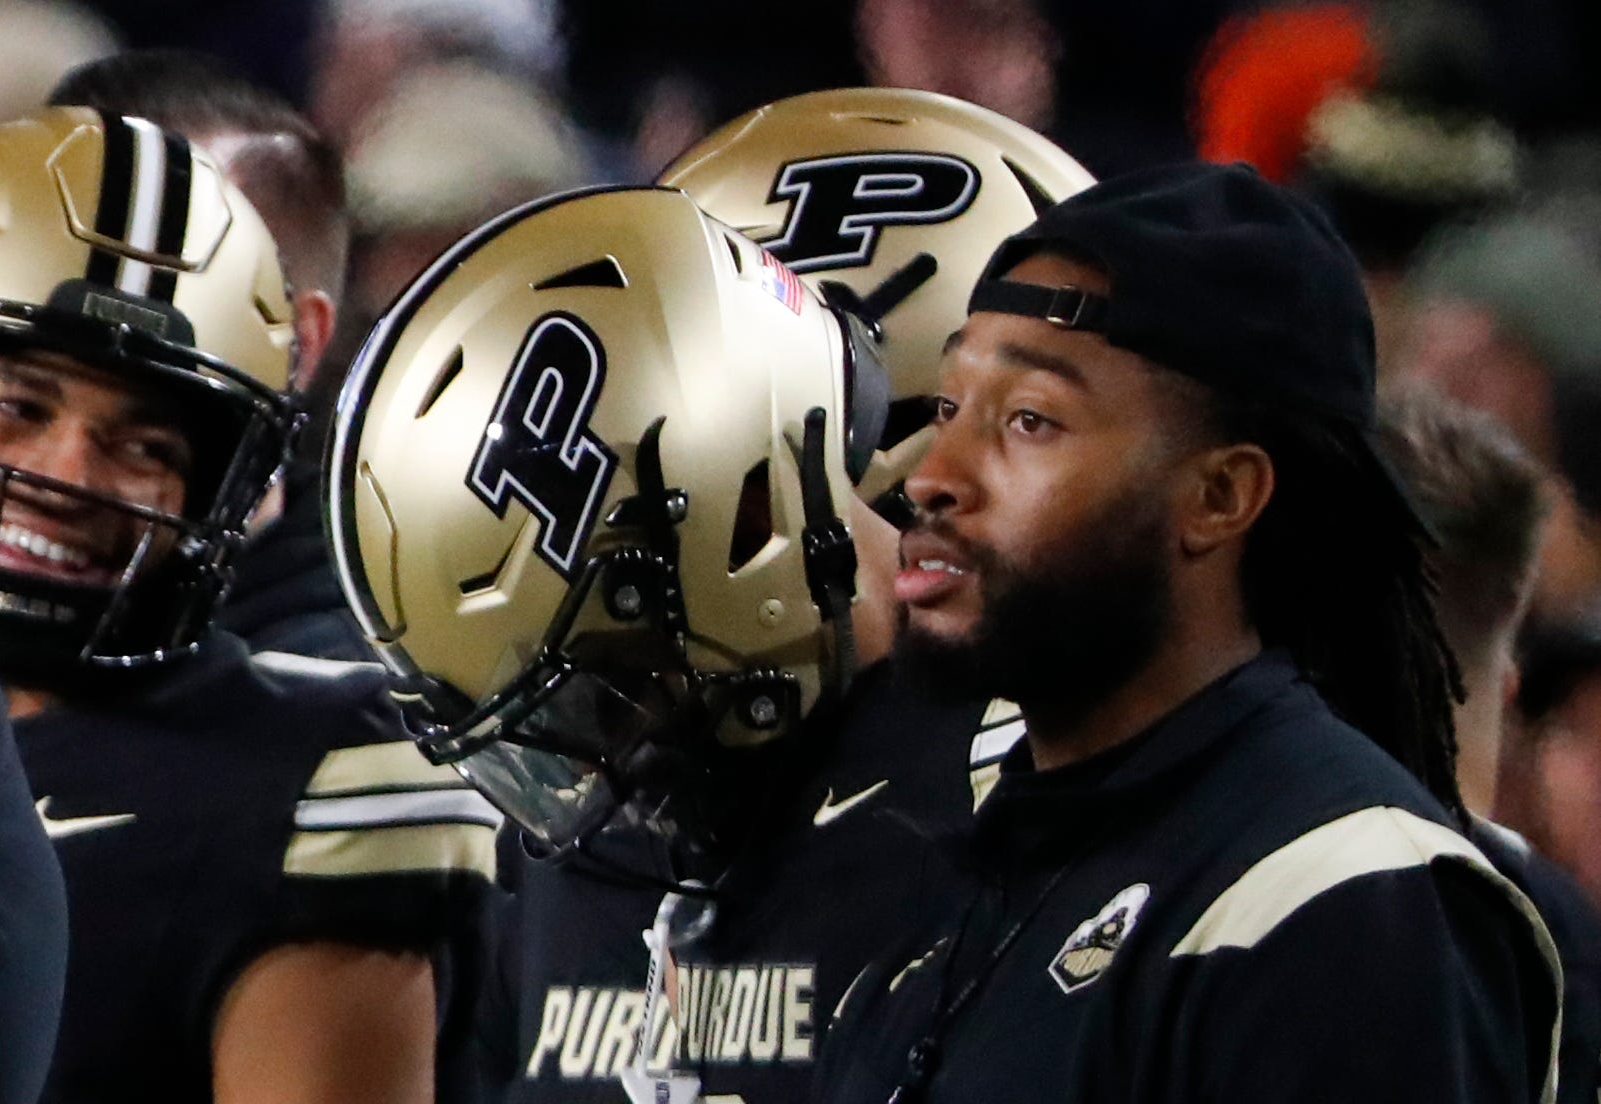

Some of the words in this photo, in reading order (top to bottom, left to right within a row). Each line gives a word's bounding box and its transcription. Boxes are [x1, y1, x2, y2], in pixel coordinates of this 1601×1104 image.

[762, 151, 982, 272] P
[464, 310, 620, 584] P
[677, 963, 814, 1060] PURDUE
